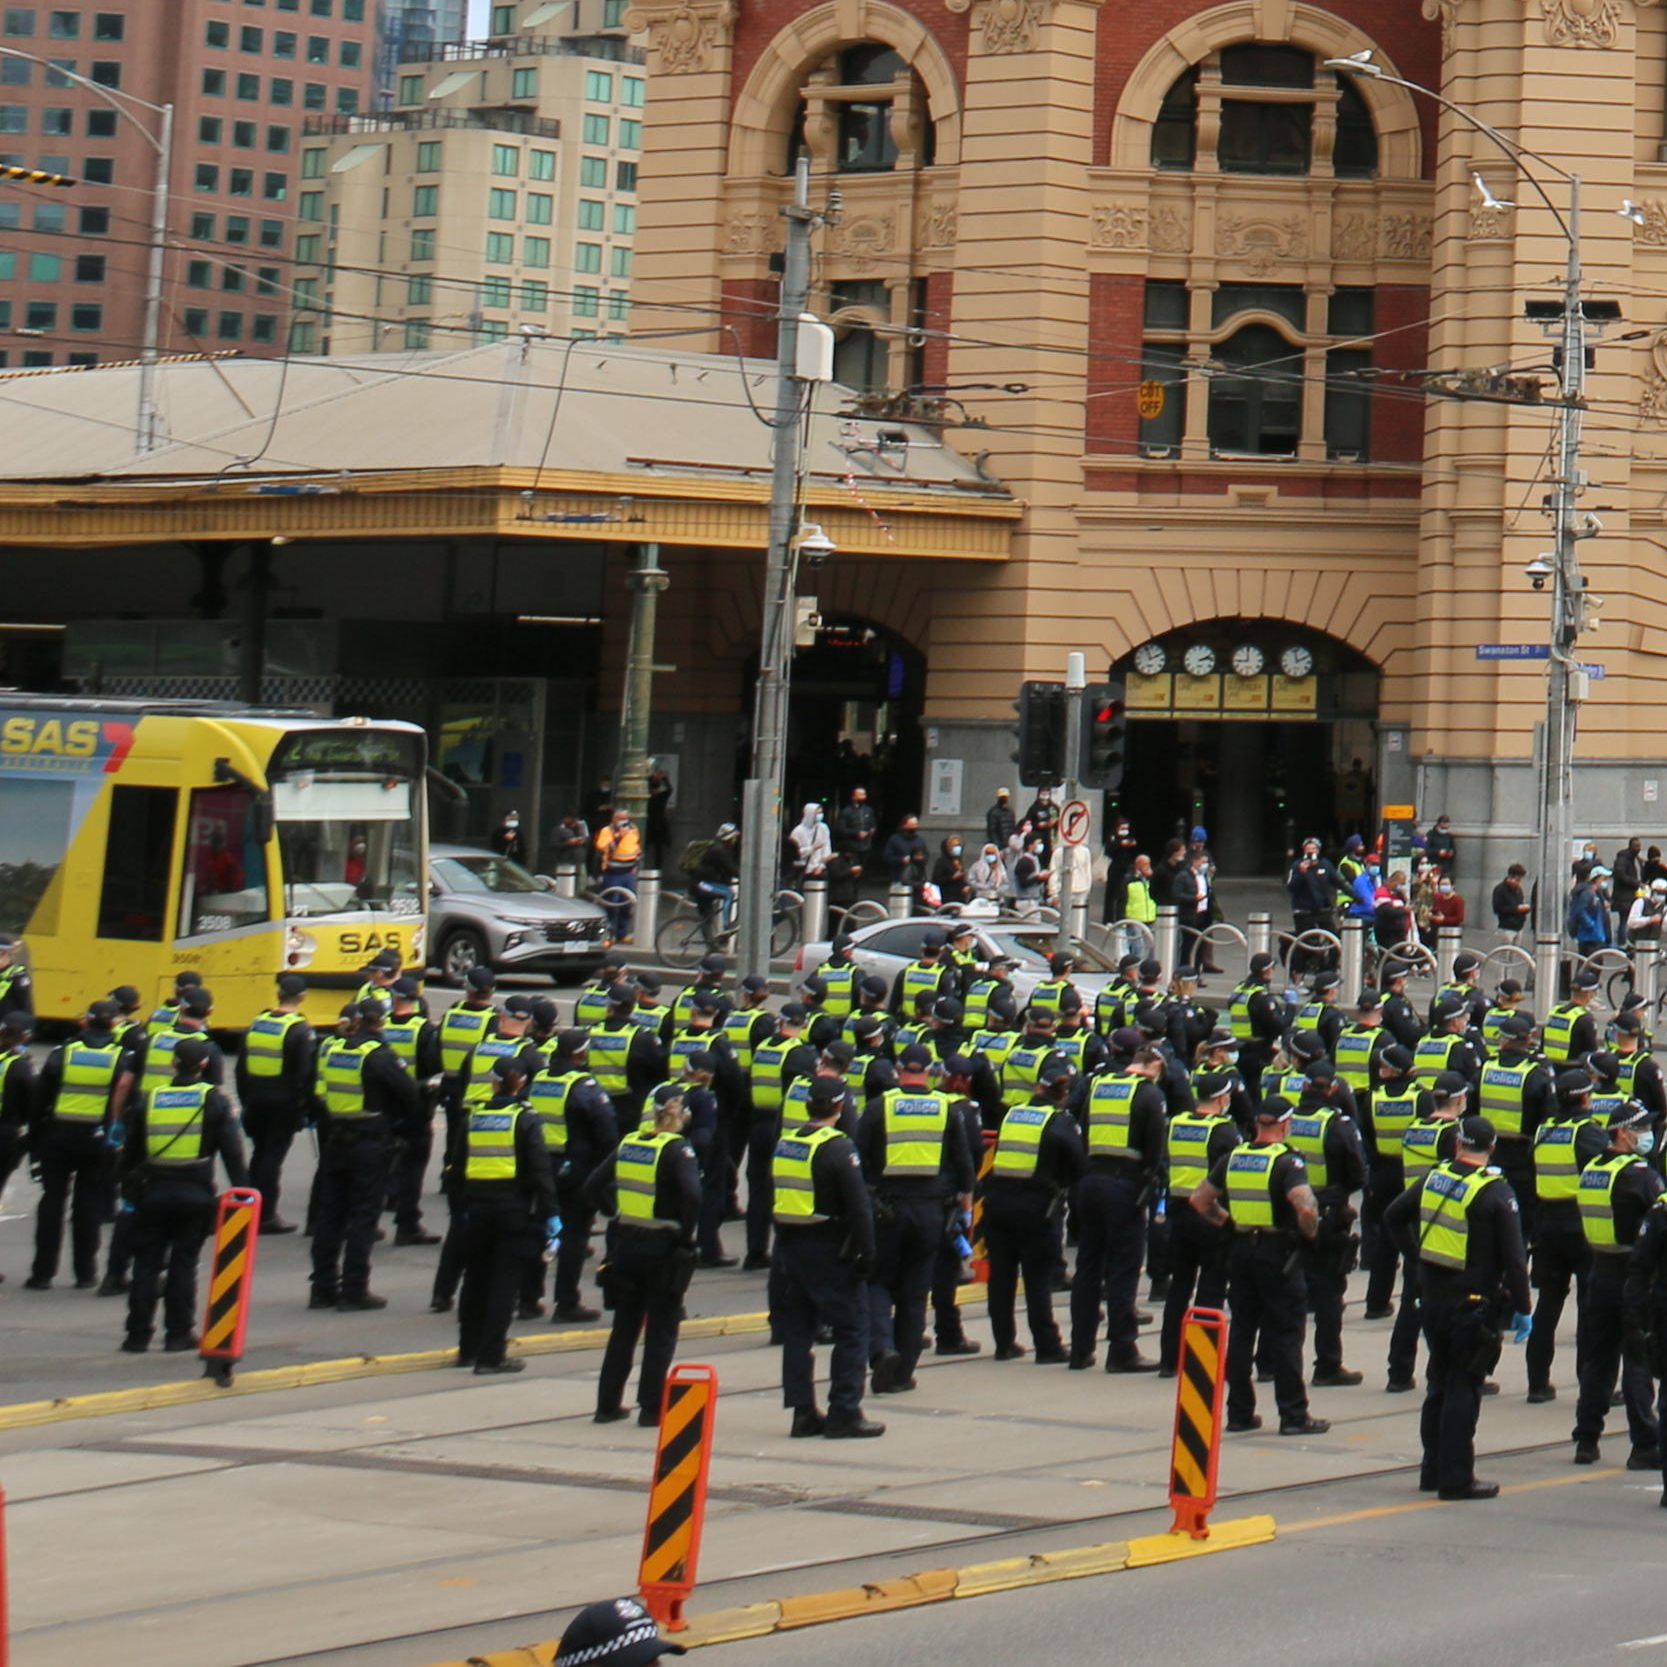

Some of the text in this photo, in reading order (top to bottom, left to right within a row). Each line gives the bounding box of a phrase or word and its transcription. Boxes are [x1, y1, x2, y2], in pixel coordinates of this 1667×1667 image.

[1140, 381, 1160, 398] CUT
[1140, 400, 1161, 414] OFF
[1, 717, 99, 756] SAS
[390, 898, 421, 915] 3508
[197, 914, 232, 931] 3508
[340, 931, 400, 954] SAS
[1096, 1084, 1129, 1097] Police
[896, 1100, 939, 1114] Police
[621, 1146, 653, 1162] Police
[775, 1142, 807, 1158] Police
[1232, 1155, 1267, 1171] Police
